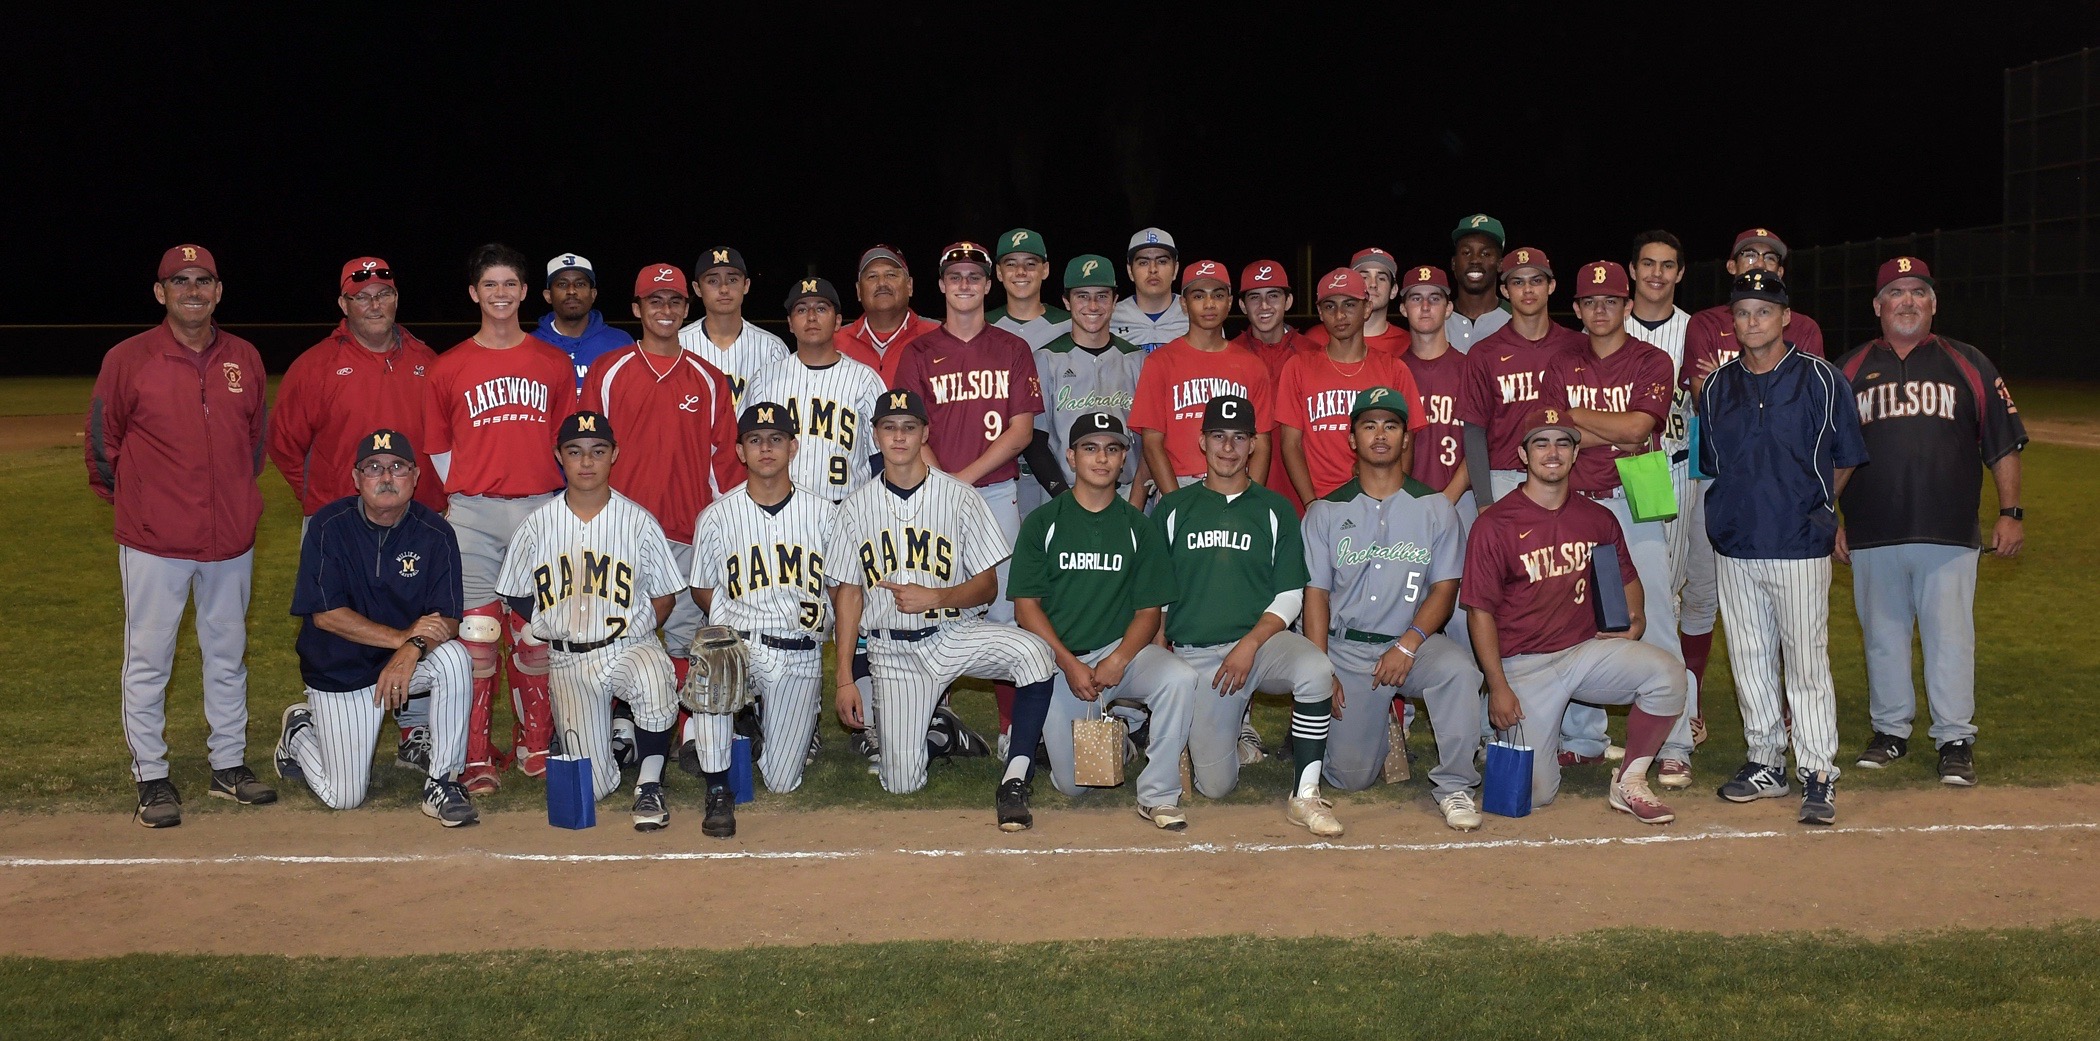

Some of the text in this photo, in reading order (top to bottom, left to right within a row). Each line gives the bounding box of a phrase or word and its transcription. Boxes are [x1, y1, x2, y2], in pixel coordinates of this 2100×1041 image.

[1471, 214, 1488, 229] P
[1012, 232, 1029, 248] P
[182, 247, 198, 262] B
[562, 255, 576, 266] J
[713, 250, 730, 264] M
[1517, 251, 1530, 265] B
[1082, 260, 1099, 278] P
[1195, 262, 1216, 276] L
[1254, 266, 1273, 281] L
[1898, 258, 1913, 273] B
[653, 268, 674, 283] L
[1329, 274, 1348, 288] L
[1418, 267, 1431, 282] B
[1592, 266, 1607, 284] B
[800, 279, 818, 294] M
[929, 369, 1011, 405] WILSON
[1496, 370, 1547, 404] WIL
[465, 376, 549, 418] LAKEWOOD
[679, 394, 699, 413] L
[890, 393, 908, 410] M
[1369, 388, 1390, 405] P
[1856, 380, 1957, 425] WILSON
[1221, 401, 1238, 419] C
[1306, 388, 1362, 424] LAKEW
[473, 413, 546, 428] BASEBALL
[577, 415, 596, 432] M
[756, 407, 775, 424] M
[786, 396, 857, 452] AMS
[1094, 413, 1110, 429] C
[1545, 409, 1560, 425] B
[983, 410, 1003, 442] 9
[373, 434, 391, 450] M
[1439, 435, 1459, 468] 3
[829, 454, 849, 487] 9
[1187, 529, 1252, 551] CABRILLO
[858, 526, 952, 590] RAMS
[1336, 536, 1432, 569] Jackrabbits
[402, 559, 415, 573] M
[1059, 551, 1123, 572] CABRILLO
[726, 543, 824, 601] RAMS
[534, 550, 632, 613] RAMS
[1404, 571, 1421, 603] 5
[605, 617, 628, 639] 2
[1886, 745, 1899, 759] N
[1753, 774, 1774, 790] N
